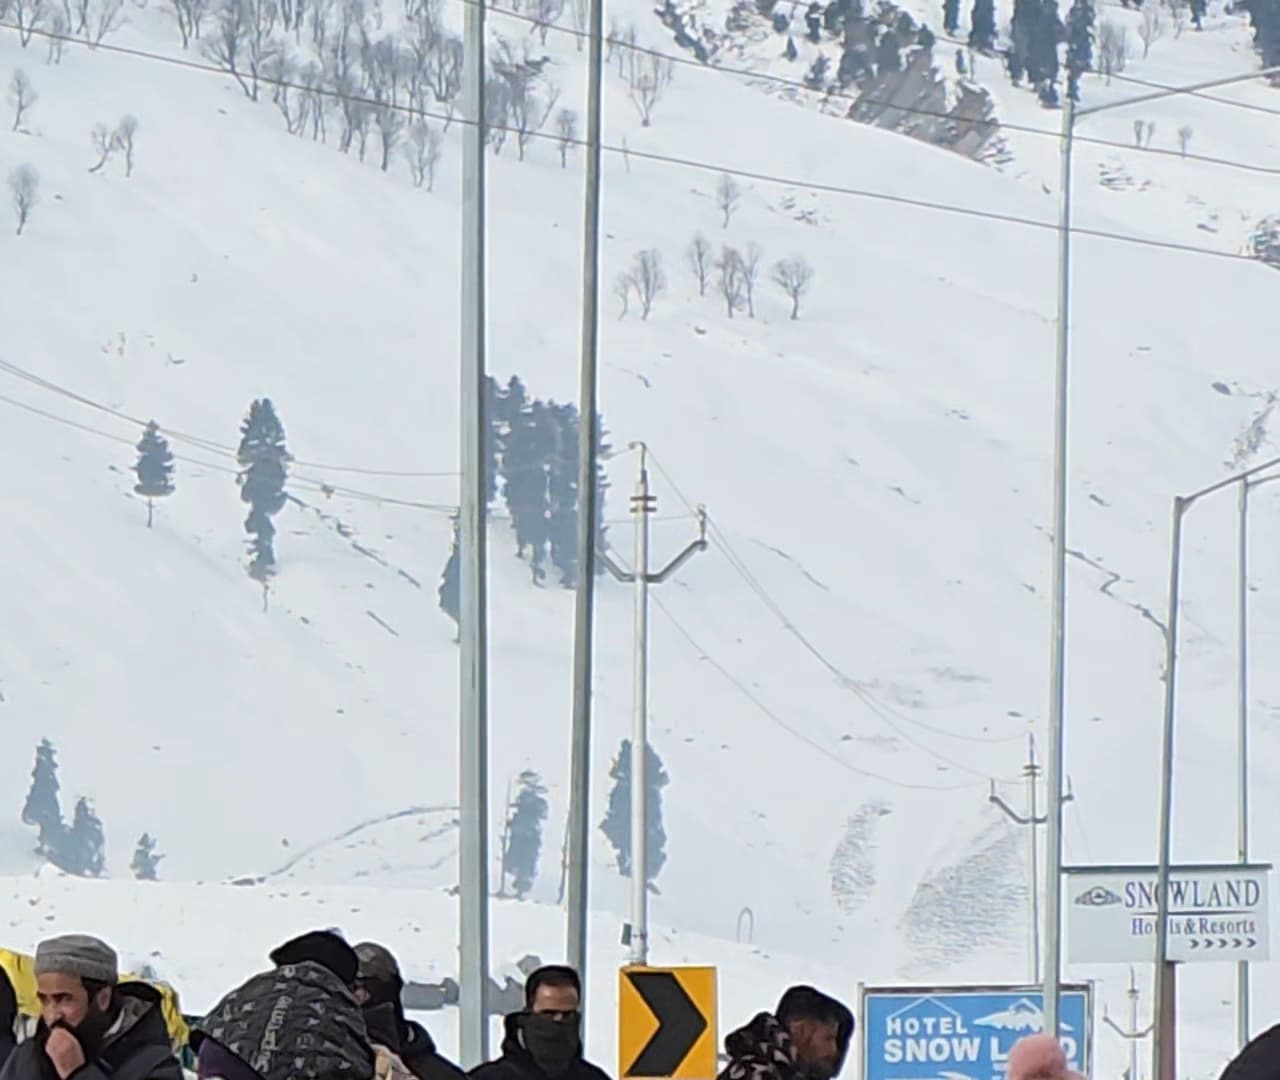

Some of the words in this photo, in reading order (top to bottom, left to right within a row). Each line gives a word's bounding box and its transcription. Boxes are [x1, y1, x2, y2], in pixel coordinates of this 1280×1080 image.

[1131, 918, 1181, 936] Hols
[886, 1016, 968, 1036] HOTEL
[884, 1037, 980, 1064] SNOW
[991, 1037, 1077, 1061] LD
